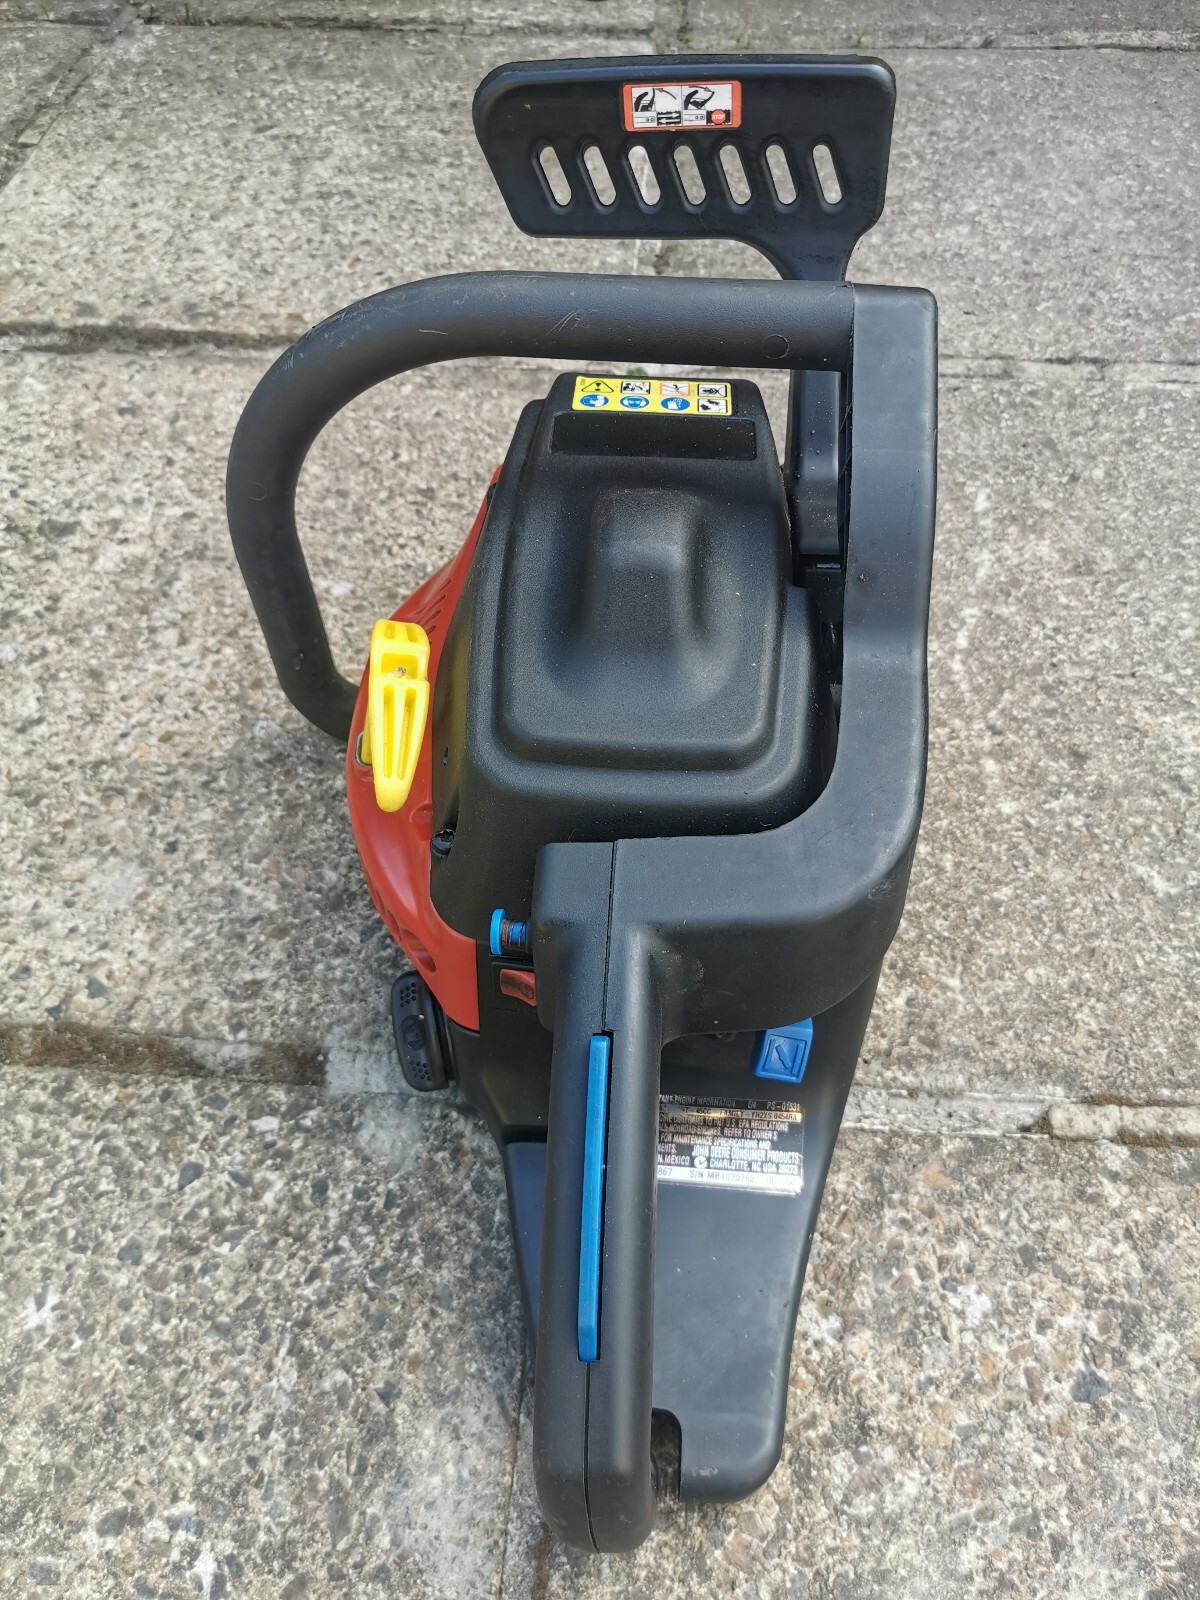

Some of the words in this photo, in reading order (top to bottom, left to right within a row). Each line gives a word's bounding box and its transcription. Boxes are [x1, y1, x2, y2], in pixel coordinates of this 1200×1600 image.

[675, 1095, 696, 1104] ENGINE
[696, 1097, 736, 1107] INFORMATION
[705, 1117, 712, 1125] TO
[725, 1119, 736, 1127] U.S.
[738, 1119, 750, 1128] EPA
[751, 1120, 789, 1132] REGULATIONS
[723, 1127, 742, 1137] REFER
[743, 1129, 751, 1137] TO
[660, 1133, 672, 1142] FOR
[673, 1134, 712, 1145] MAINTENANCE
[714, 1137, 758, 1148] SPECIFICATIONS
[759, 1140, 771, 1149] AND
[692, 1145, 709, 1156] JOHN
[710, 1146, 730, 1158] DEERE
[731, 1147, 766, 1161] CONSUMER
[767, 1151, 799, 1164] PRODUCTS
[690, 1169, 704, 1178] S/N
[752, 1161, 762, 1171] NC
[763, 1163, 777, 1172] USA
[778, 1164, 798, 1174] 28273
